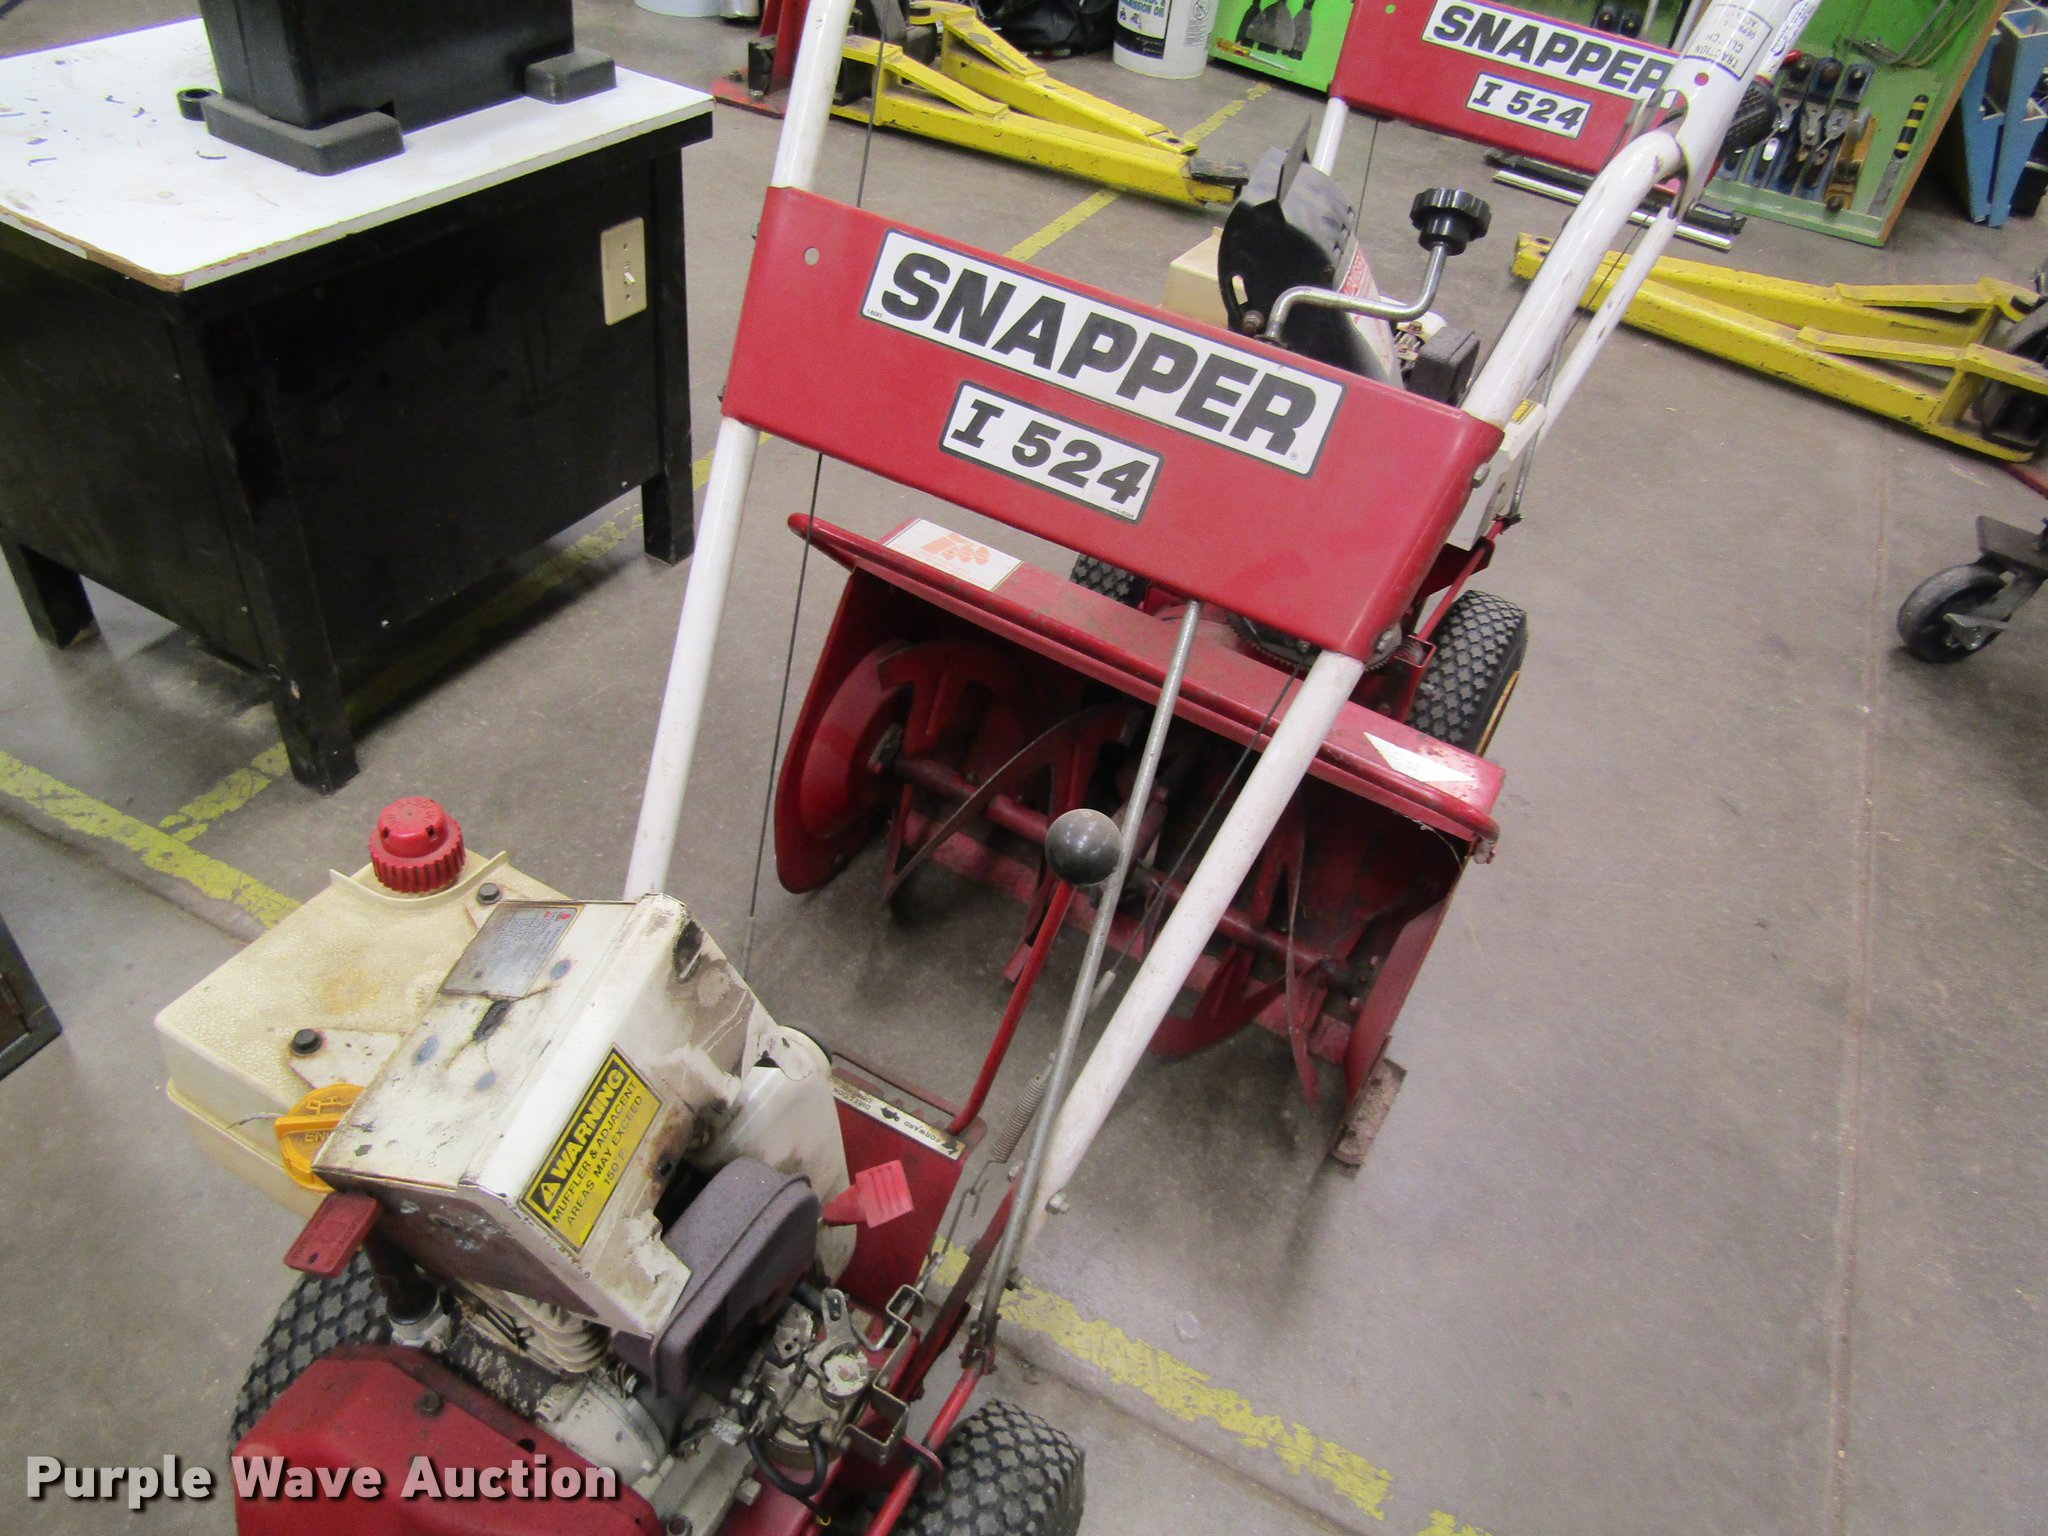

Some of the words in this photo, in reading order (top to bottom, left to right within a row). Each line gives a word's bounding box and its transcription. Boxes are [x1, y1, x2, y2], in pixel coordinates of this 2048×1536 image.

[1433, 4, 1673, 95] SNAPPER
[1705, 33, 1744, 54] CLCH
[1471, 81, 1502, 107] I
[1506, 91, 1585, 130] 524
[880, 251, 1317, 456] SNAPPER
[950, 398, 1005, 449] I
[1011, 420, 1152, 505] 524
[551, 1068, 625, 1180] WARNING
[551, 1161, 592, 1224] MUFFLER
[589, 1149, 598, 1160] &
[596, 1079, 638, 1148] ADJACENT
[567, 1181, 596, 1228] AREAS
[593, 1147, 613, 1178] MAY
[612, 1095, 643, 1147] EXCEED
[903, 1120, 942, 1143] FORWARD
